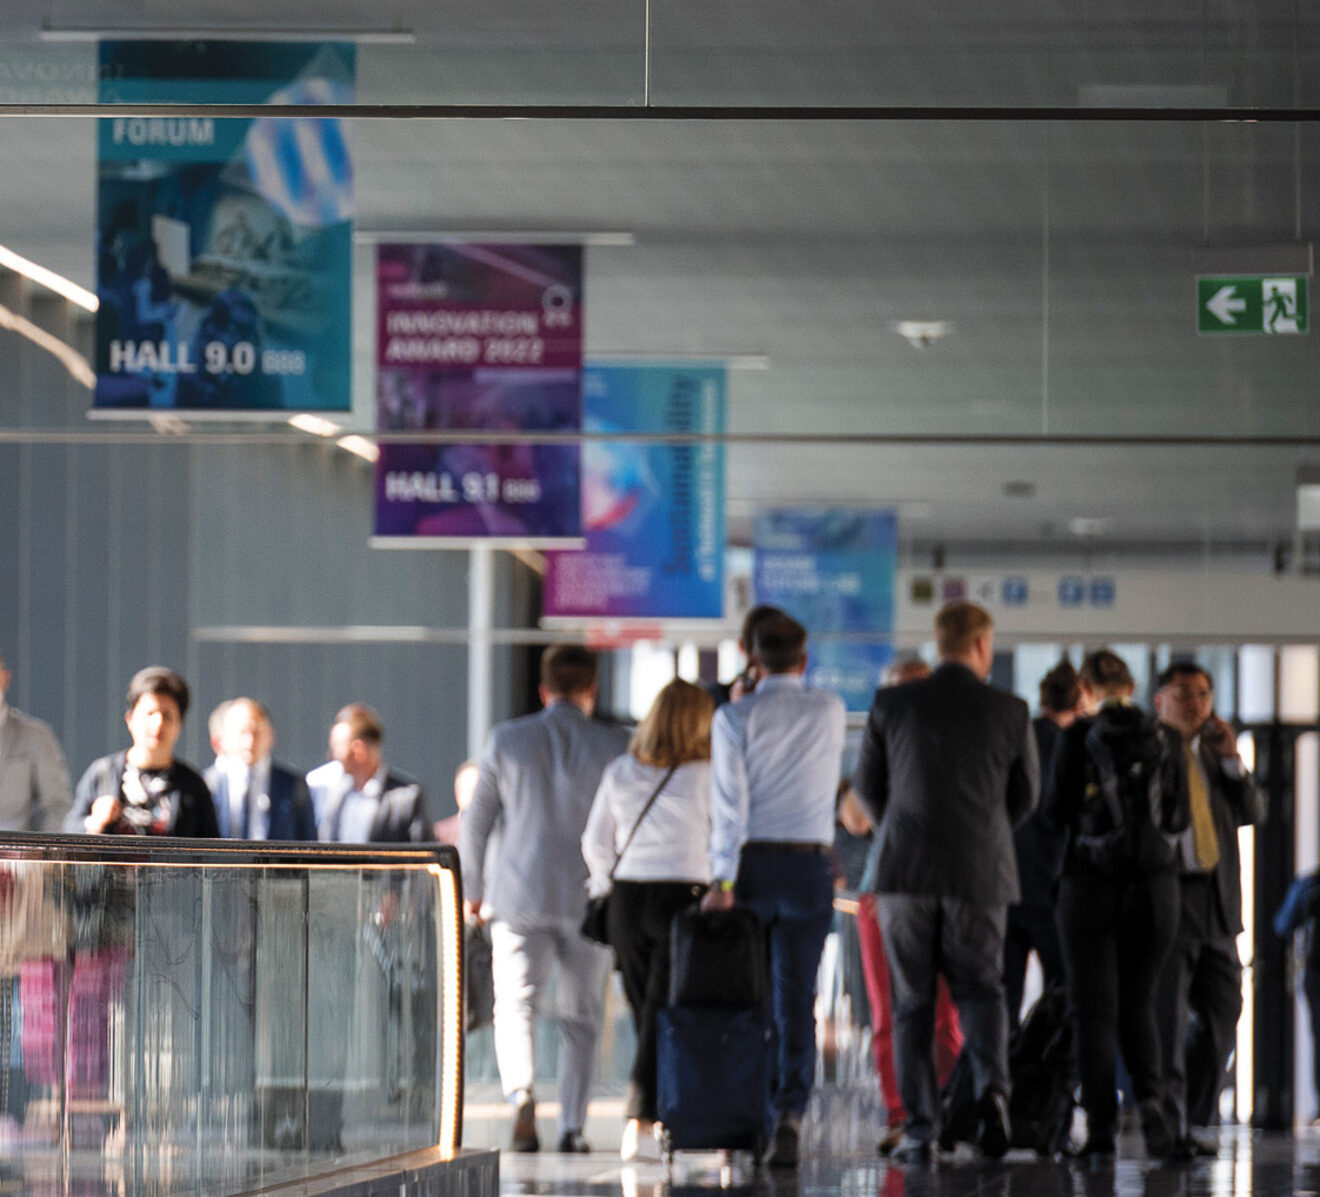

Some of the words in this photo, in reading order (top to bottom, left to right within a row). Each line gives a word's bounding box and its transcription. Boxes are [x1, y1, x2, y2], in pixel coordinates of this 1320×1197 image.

[113, 117, 215, 145] FORUM
[386, 309, 539, 335] INNOVATION
[109, 340, 198, 374] HALL
[204, 340, 256, 375] 9.0
[385, 337, 479, 363] AWARD
[385, 471, 459, 502] HALL
